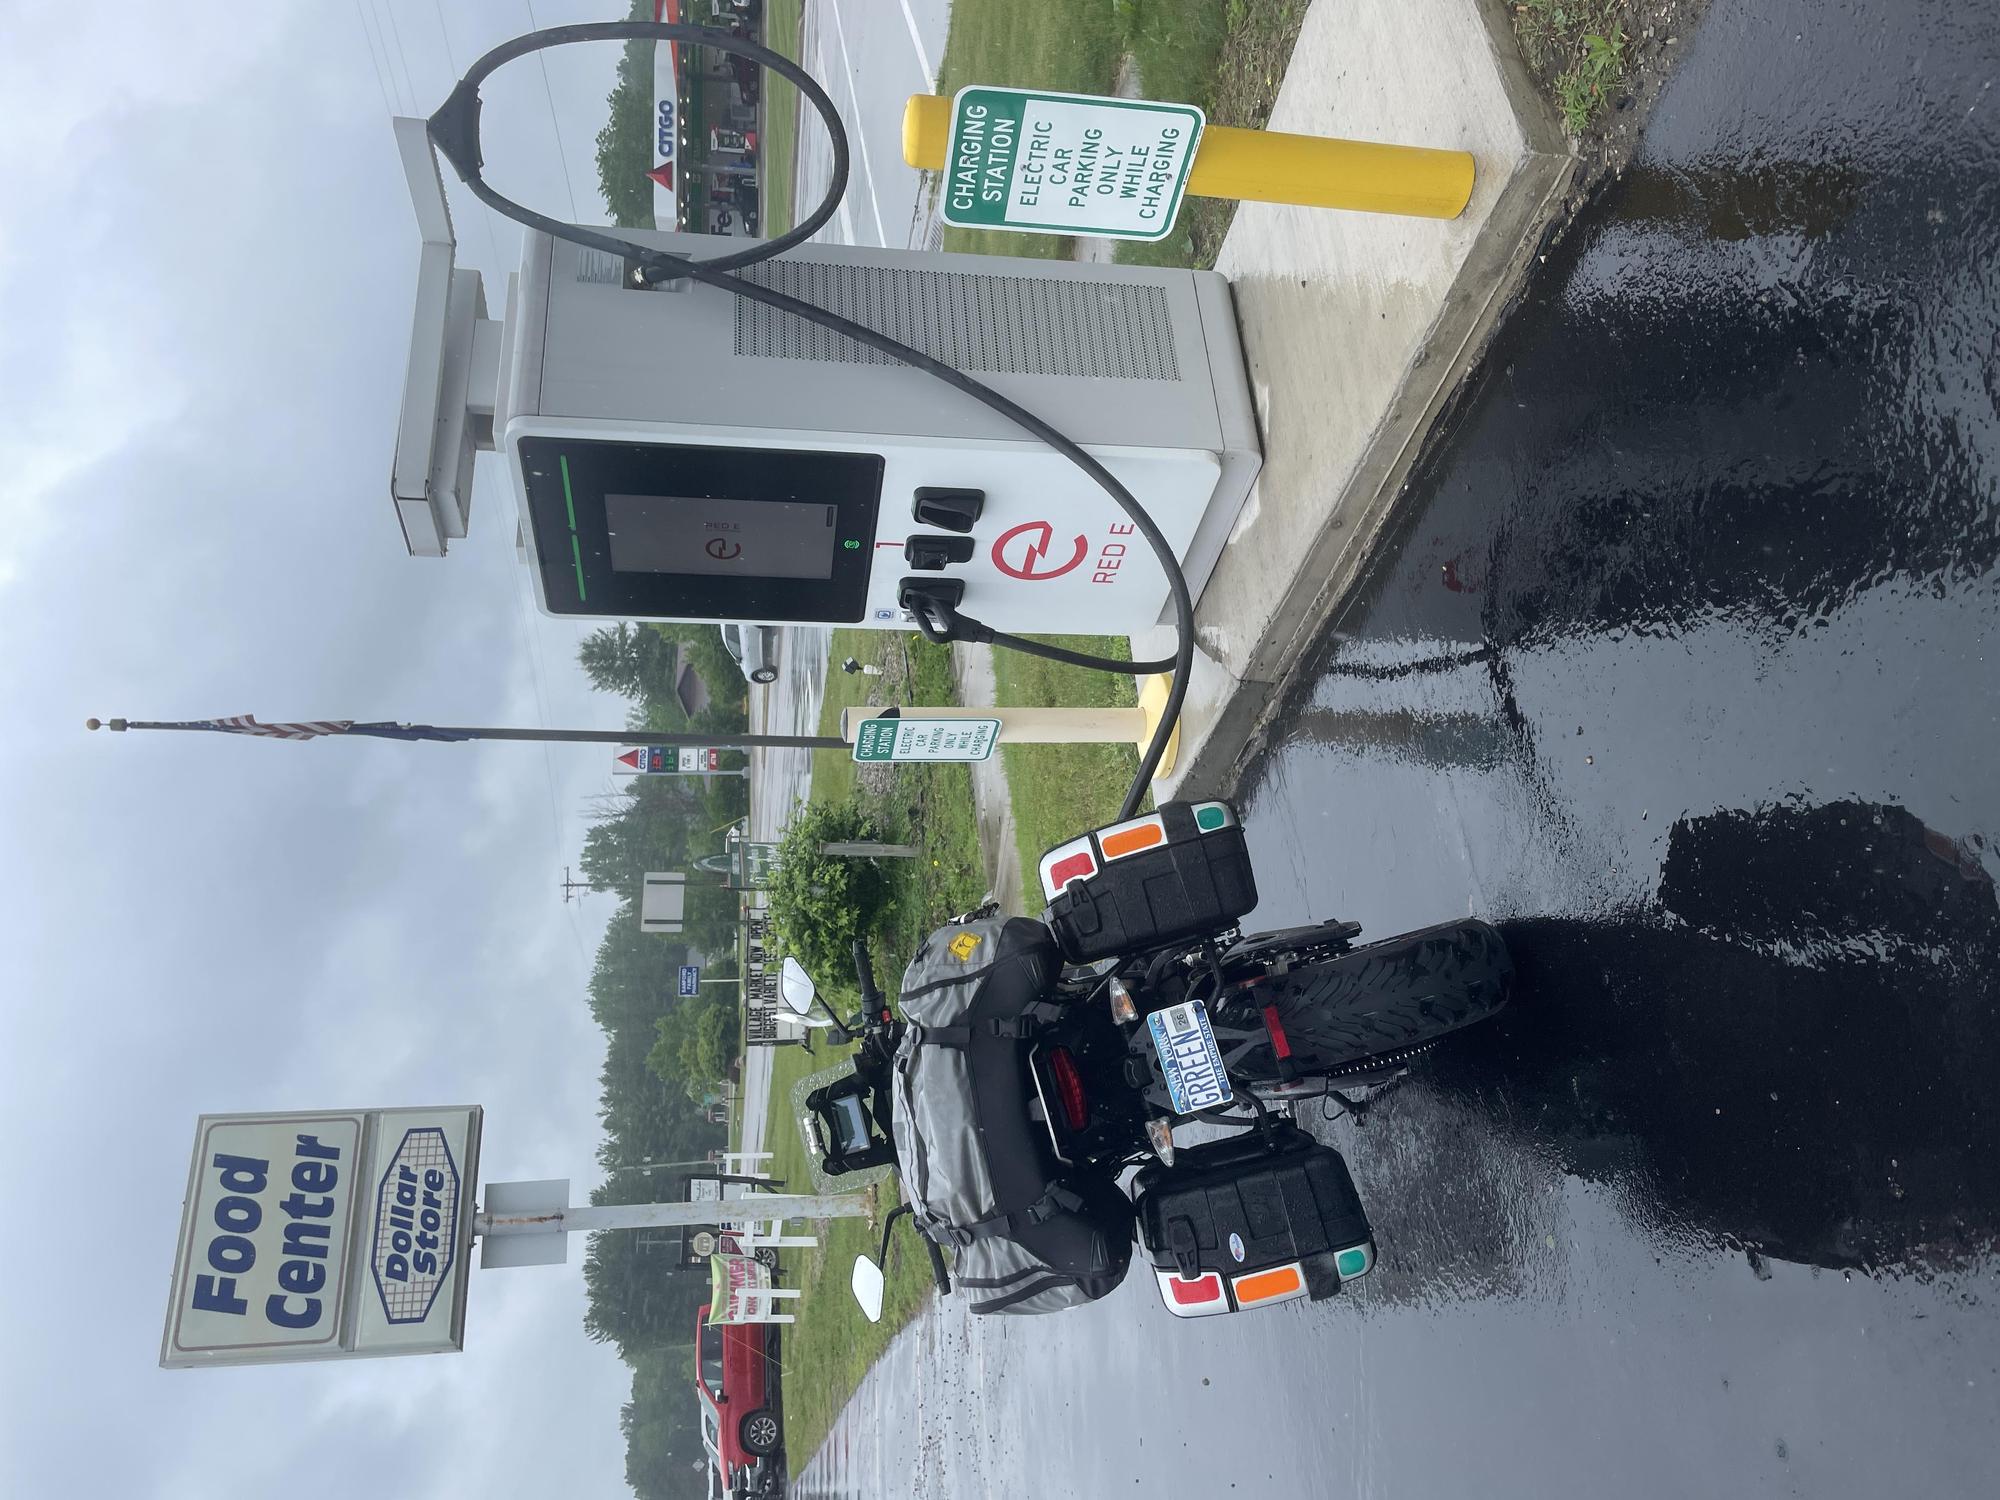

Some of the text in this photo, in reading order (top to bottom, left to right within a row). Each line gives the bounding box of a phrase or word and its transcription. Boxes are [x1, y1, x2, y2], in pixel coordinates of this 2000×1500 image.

[658, 100, 674, 157] CITGO
[952, 105, 988, 210] CHARGING
[982, 118, 1016, 202] STATION
[1019, 121, 1052, 206] ELECTRIC
[1049, 149, 1073, 185] CAR
[1068, 128, 1102, 208] PARKING
[1096, 146, 1123, 195] ONLY
[1120, 145, 1150, 199] WHILE
[1138, 128, 1180, 219] CHARGING
[1092, 523, 1135, 583] RED E
[860, 724, 878, 757] CHARGING
[878, 728, 894, 754] STATION
[899, 727, 916, 754] ELECTRIC
[916, 734, 928, 747] CAR
[928, 728, 944, 754] PARKING
[944, 732, 958, 748] ONLY
[958, 732, 972, 750] WHILE
[970, 725, 989, 756] CHARGING
[750, 946, 763, 963] NOW
[749, 968, 762, 999] MARKET
[748, 1008, 762, 1040] VILLAGE
[763, 1007, 777, 1038] BIGGEST
[1176, 1013, 1186, 1025] 26
[1158, 1032, 1184, 1092] NEW YORK
[1171, 1029, 1220, 1106] GRREEN
[1200, 1017, 1226, 1084] THE EMPIRE STATE
[192, 1153, 270, 1316] Food
[266, 1134, 340, 1329] Center
[386, 1165, 418, 1282] Dollar
[414, 1168, 444, 1275] Store
